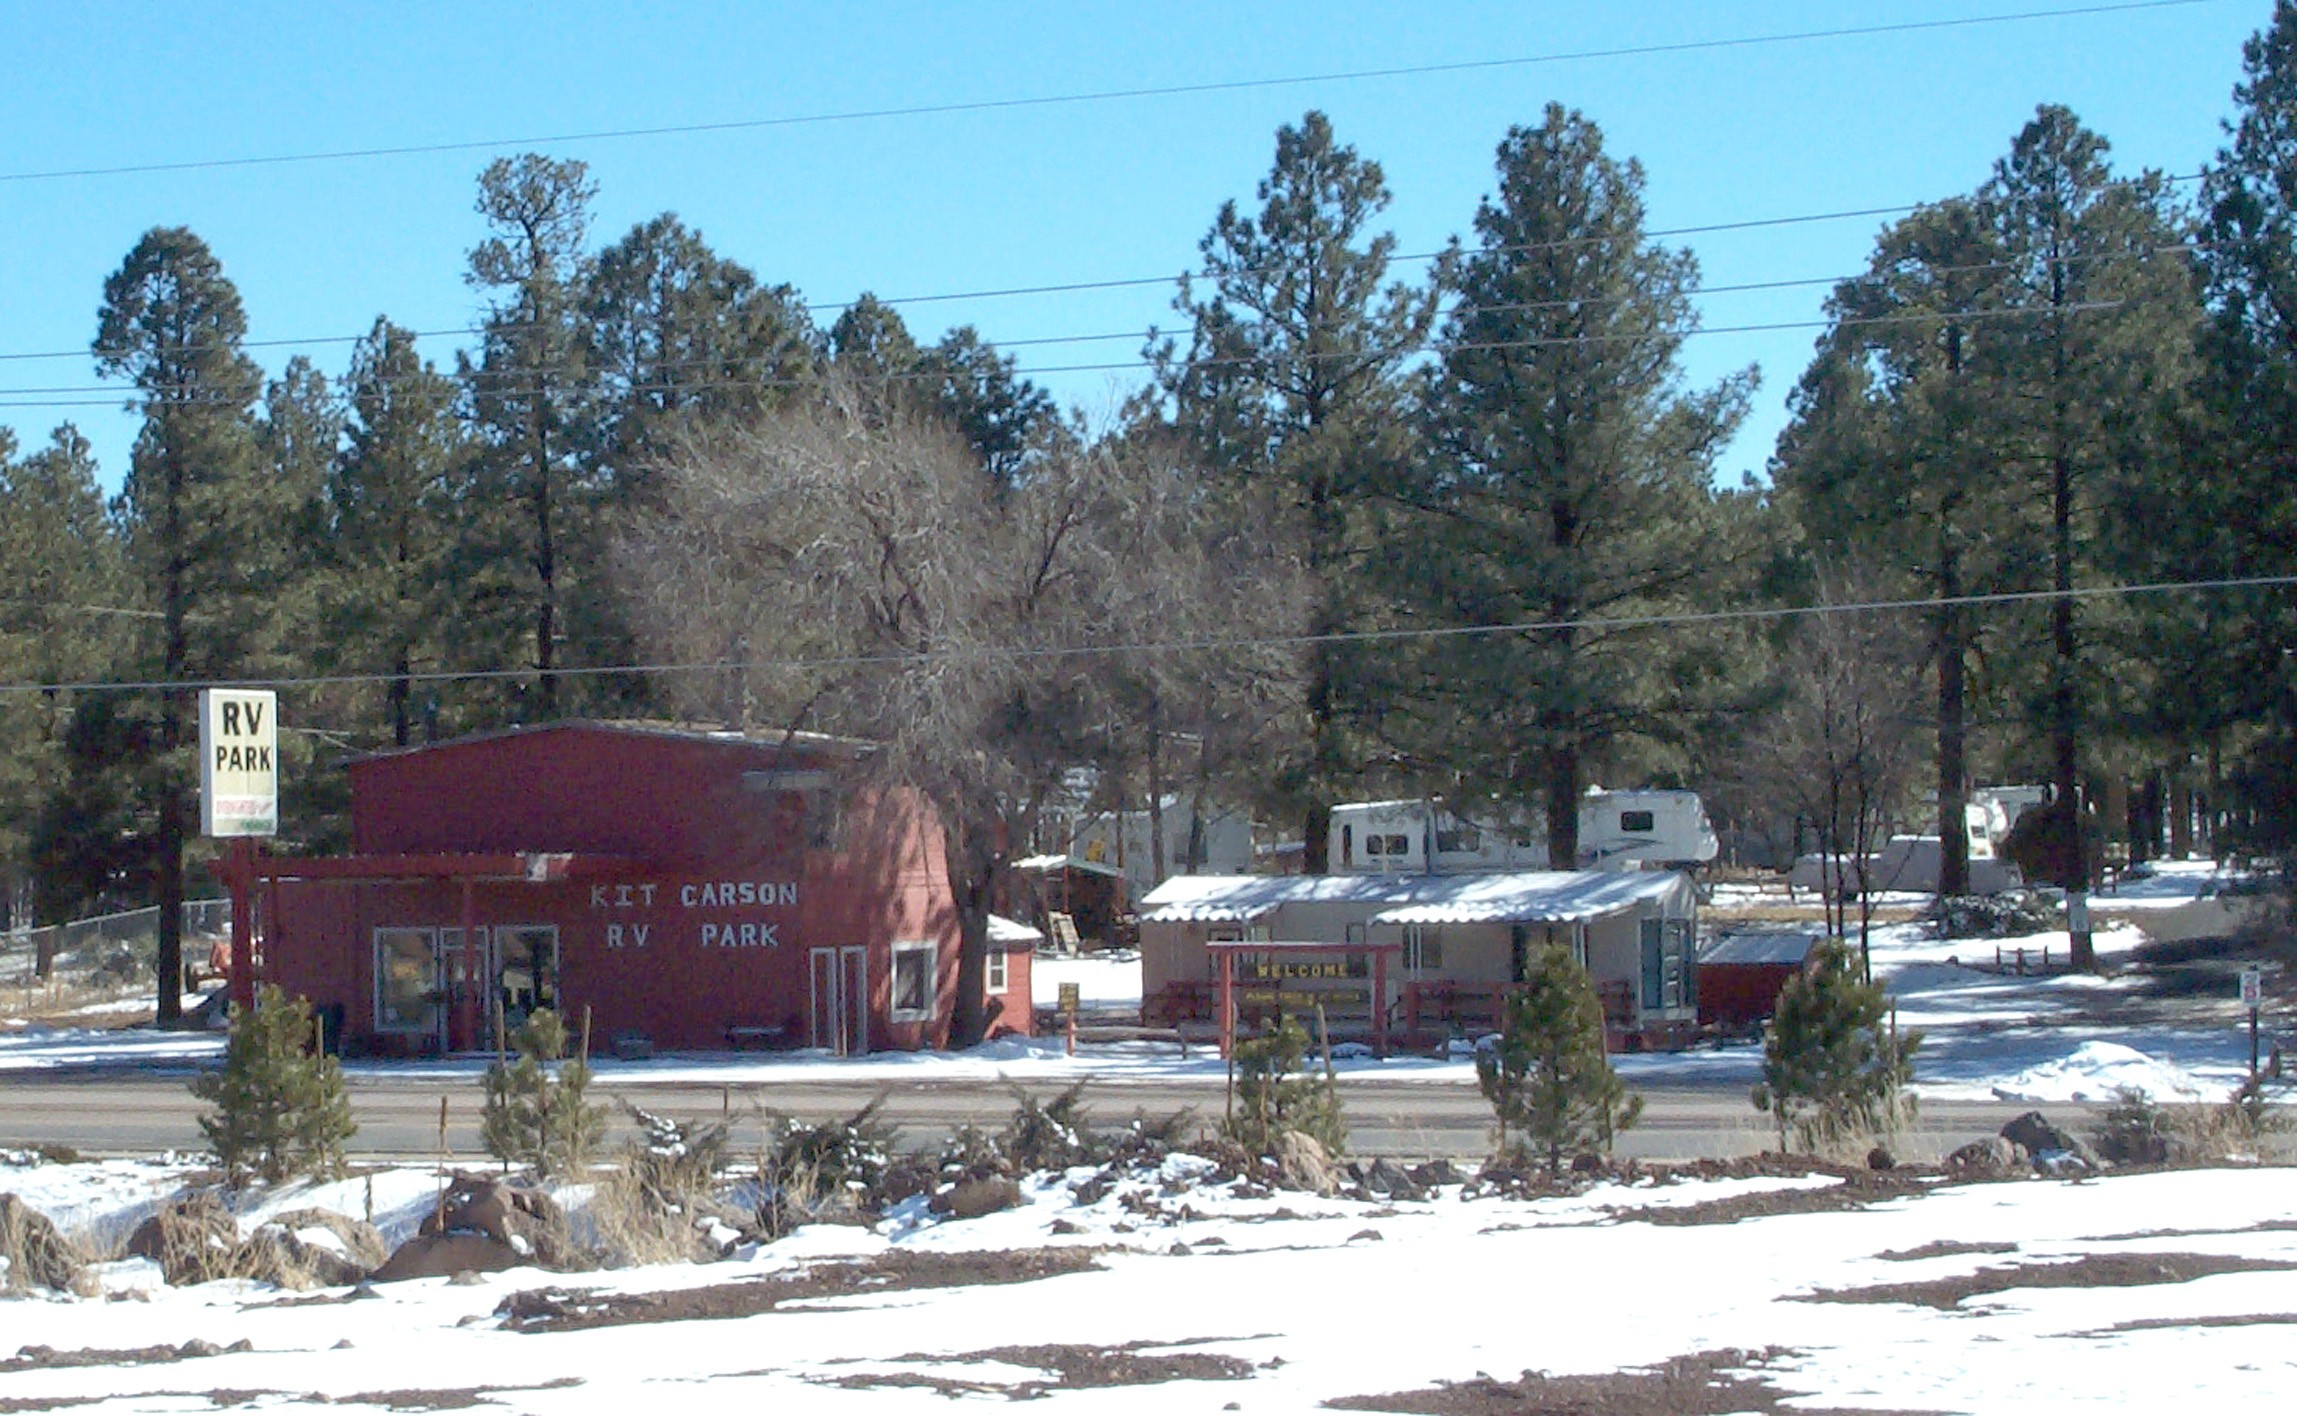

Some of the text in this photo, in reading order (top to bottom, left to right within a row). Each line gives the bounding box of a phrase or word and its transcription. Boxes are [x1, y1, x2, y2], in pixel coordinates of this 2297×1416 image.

[222, 701, 263, 736] RV
[216, 745, 271, 772] PARK
[590, 881, 798, 907] KIT CARSON
[607, 922, 779, 948] RV PARK
[1256, 962, 1348, 978] WELCOME
